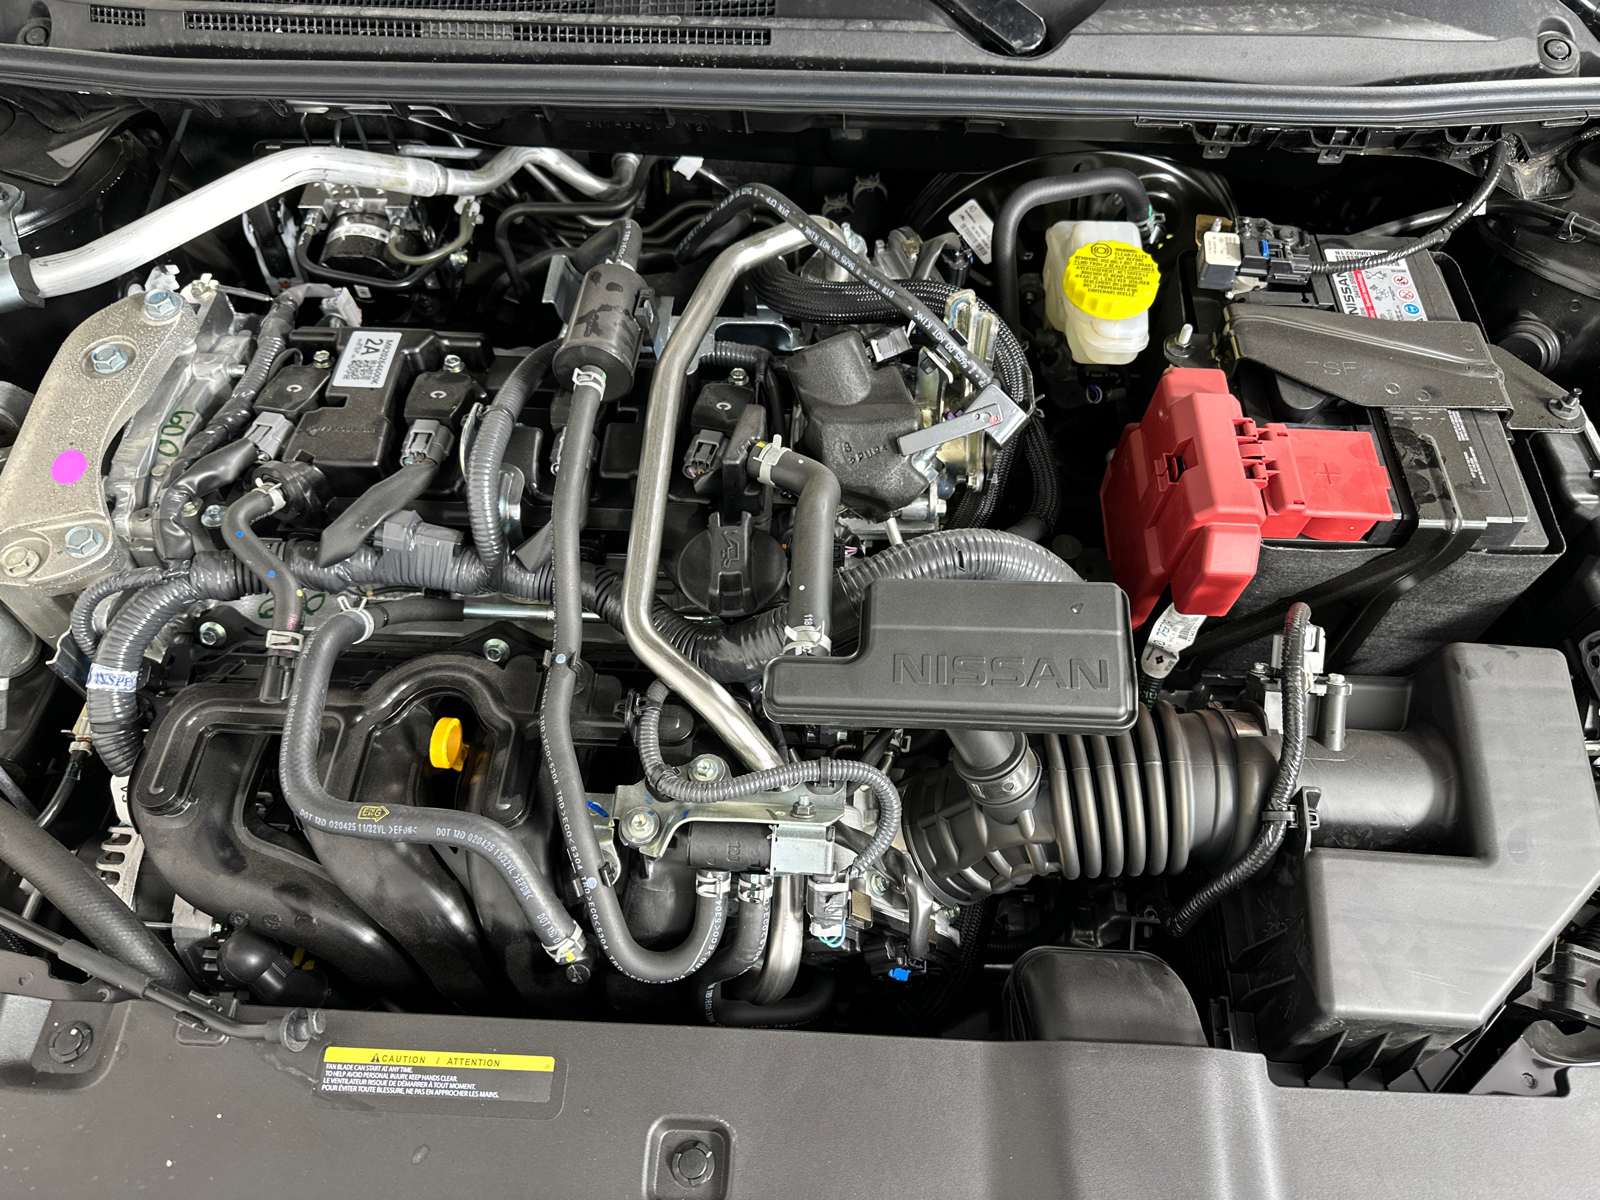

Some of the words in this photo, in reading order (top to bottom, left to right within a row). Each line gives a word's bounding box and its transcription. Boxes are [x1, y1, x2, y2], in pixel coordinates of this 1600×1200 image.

[804, 226, 818, 241] KINK
[914, 310, 932, 330] KINK
[360, 338, 384, 355] 2A
[931, 330, 946, 345] NOT
[893, 653, 1110, 691] NISSAN
[300, 808, 313, 820] DOT
[328, 820, 356, 832] 020425
[358, 824, 386, 834] 11/32VL
[436, 828, 452, 837] DOT
[468, 833, 496, 852] 020425
[494, 848, 516, 874] 11/32VL
[536, 912, 550, 930] DOT
[382, 1054, 426, 1064] CAUTION
[446, 1058, 500, 1067] ATTENTION
